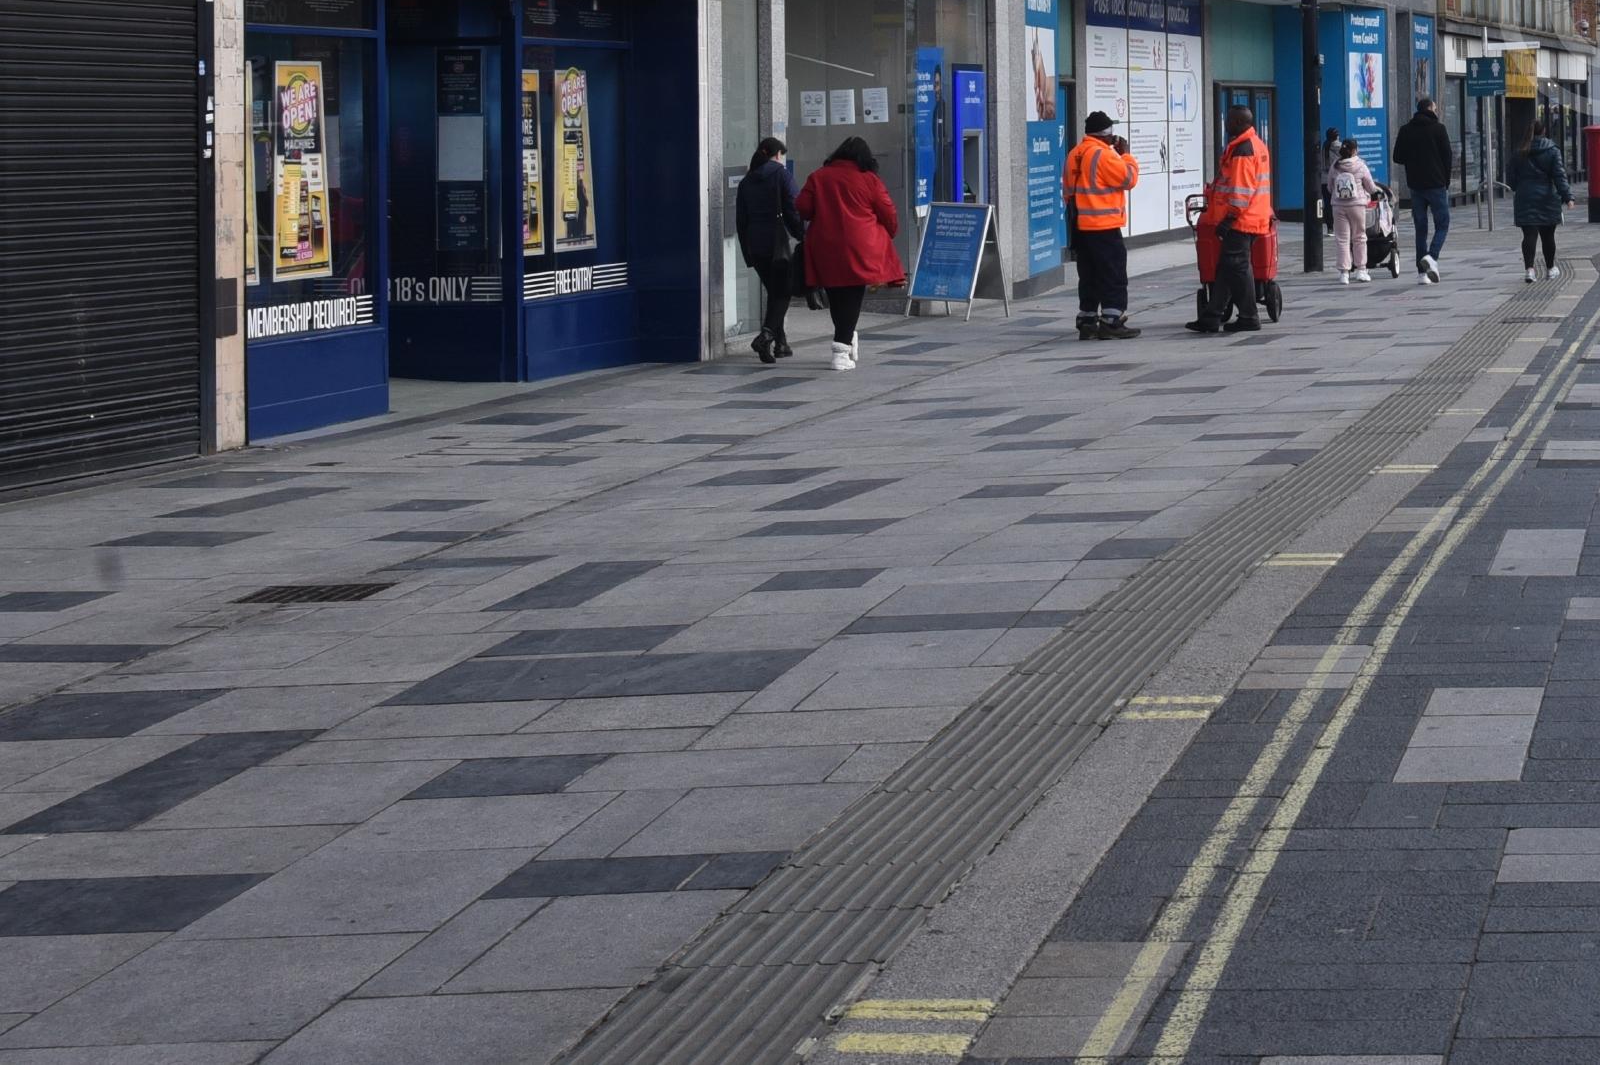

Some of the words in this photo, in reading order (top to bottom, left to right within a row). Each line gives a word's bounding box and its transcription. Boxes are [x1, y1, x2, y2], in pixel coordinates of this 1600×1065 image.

[281, 88, 296, 107] WE
[299, 80, 317, 100] ARE
[562, 81, 571, 95] WE
[572, 74, 585, 89] ARE
[282, 99, 317, 129] OPEN!
[562, 90, 586, 113] OPEN!
[429, 277, 469, 303] ONLY
[555, 268, 571, 295] FREE
[571, 266, 593, 292] ENTRY
[247, 305, 312, 339] MEMBERSHIP
[313, 296, 357, 330] REQUIRED
